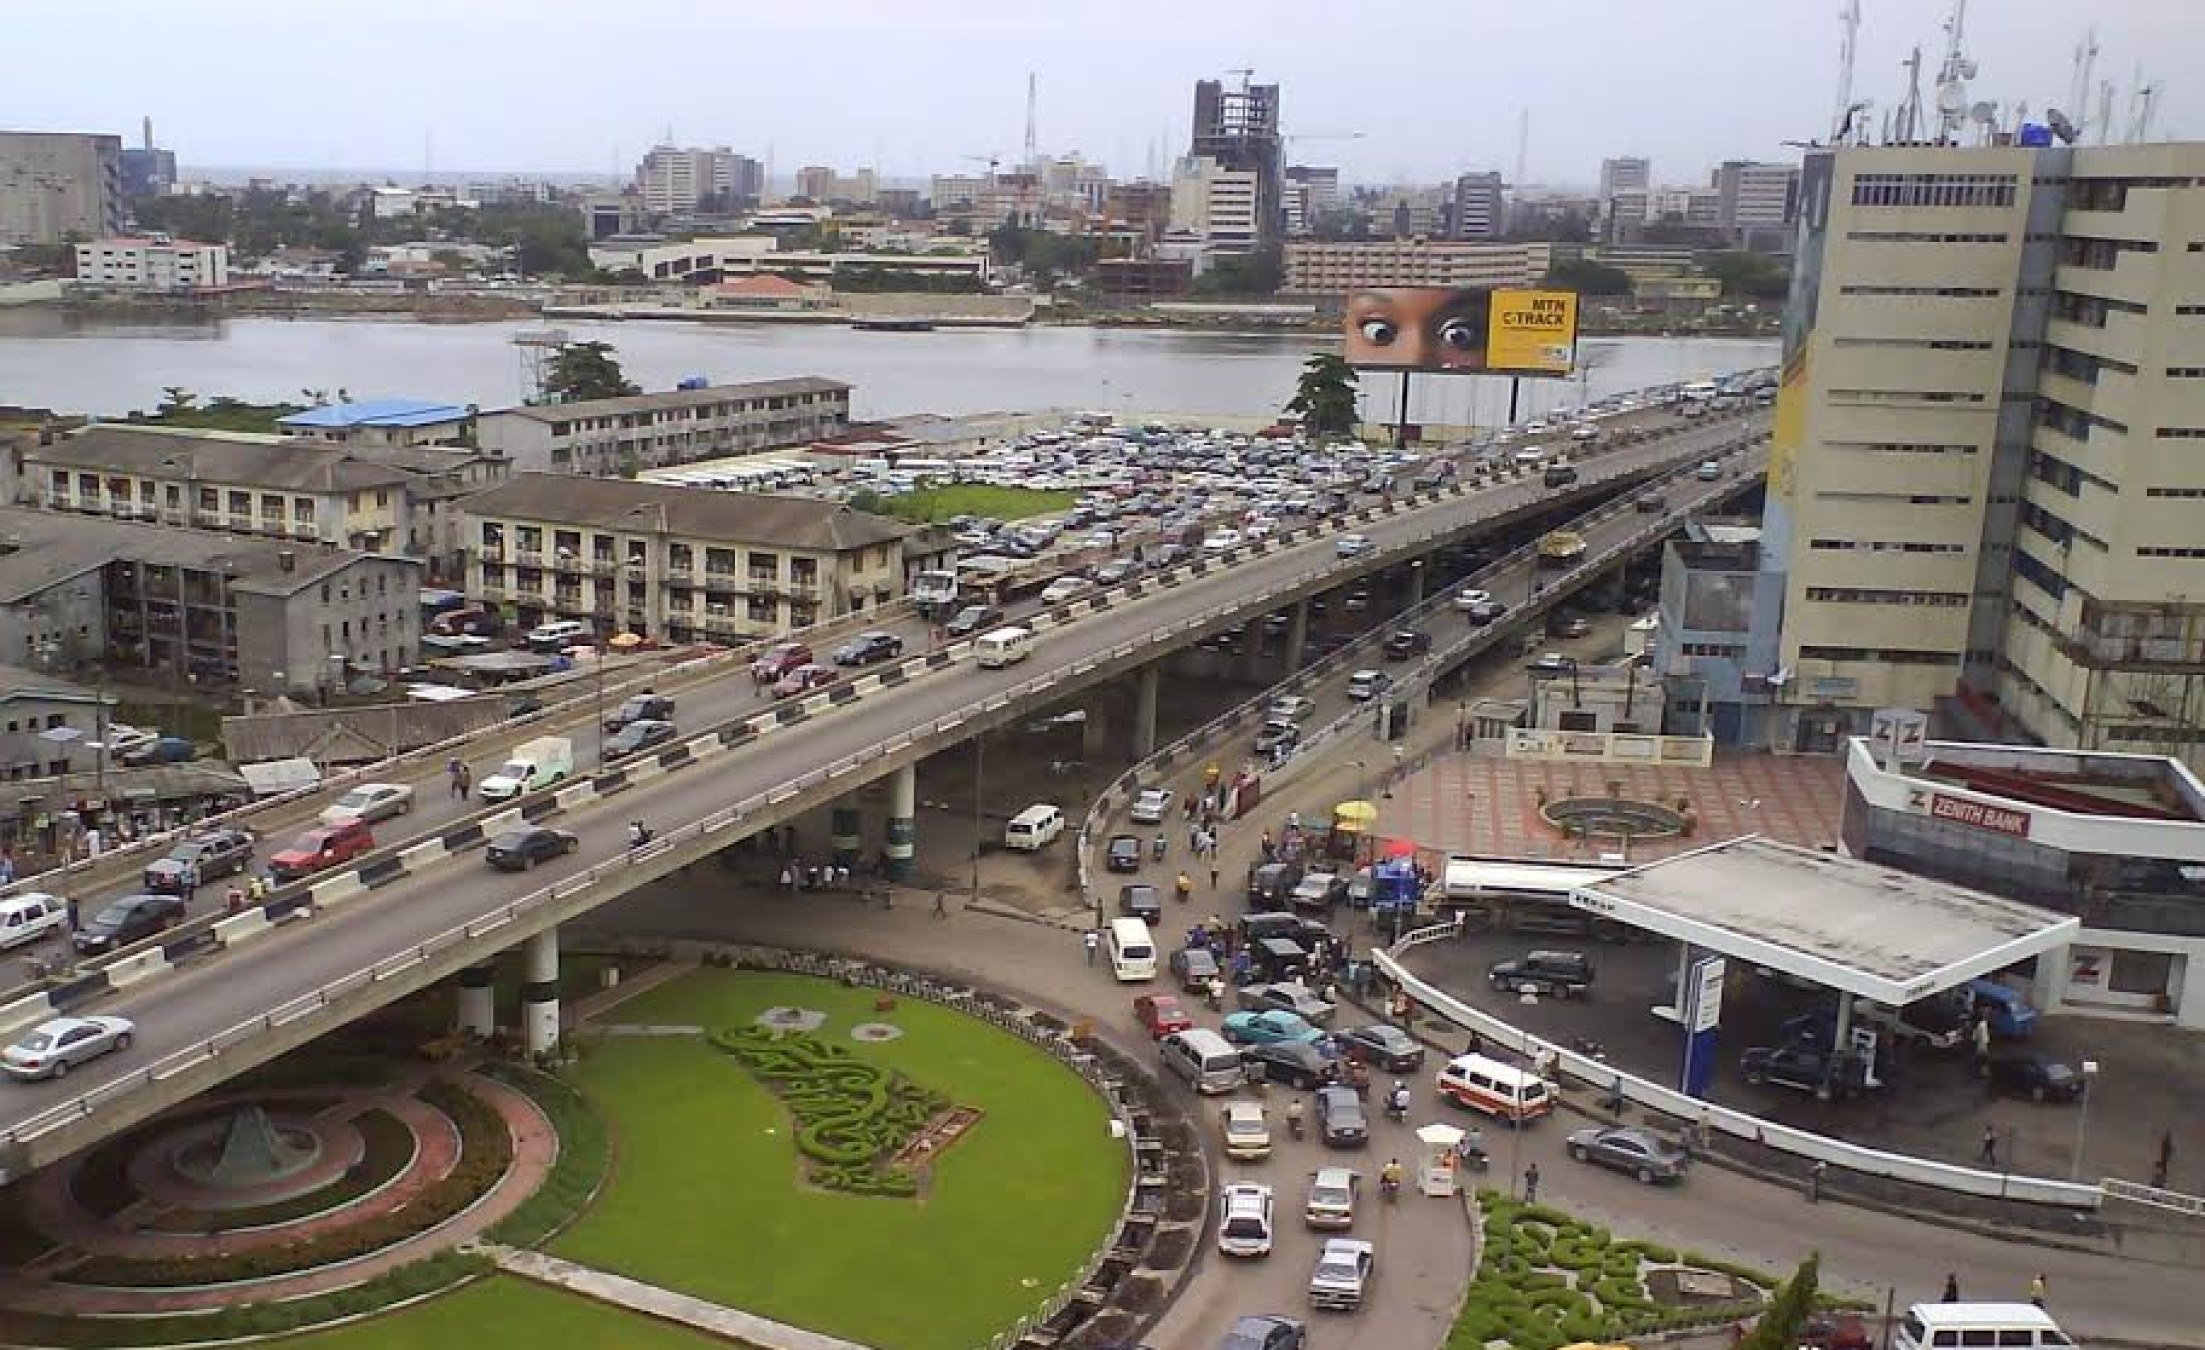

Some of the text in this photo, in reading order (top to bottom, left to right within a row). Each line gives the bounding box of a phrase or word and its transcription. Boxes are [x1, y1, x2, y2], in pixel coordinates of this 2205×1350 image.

[1532, 299, 1565, 311] MTN
[1933, 797, 1984, 824] ZENITH
[1982, 808, 2025, 834] BANK
